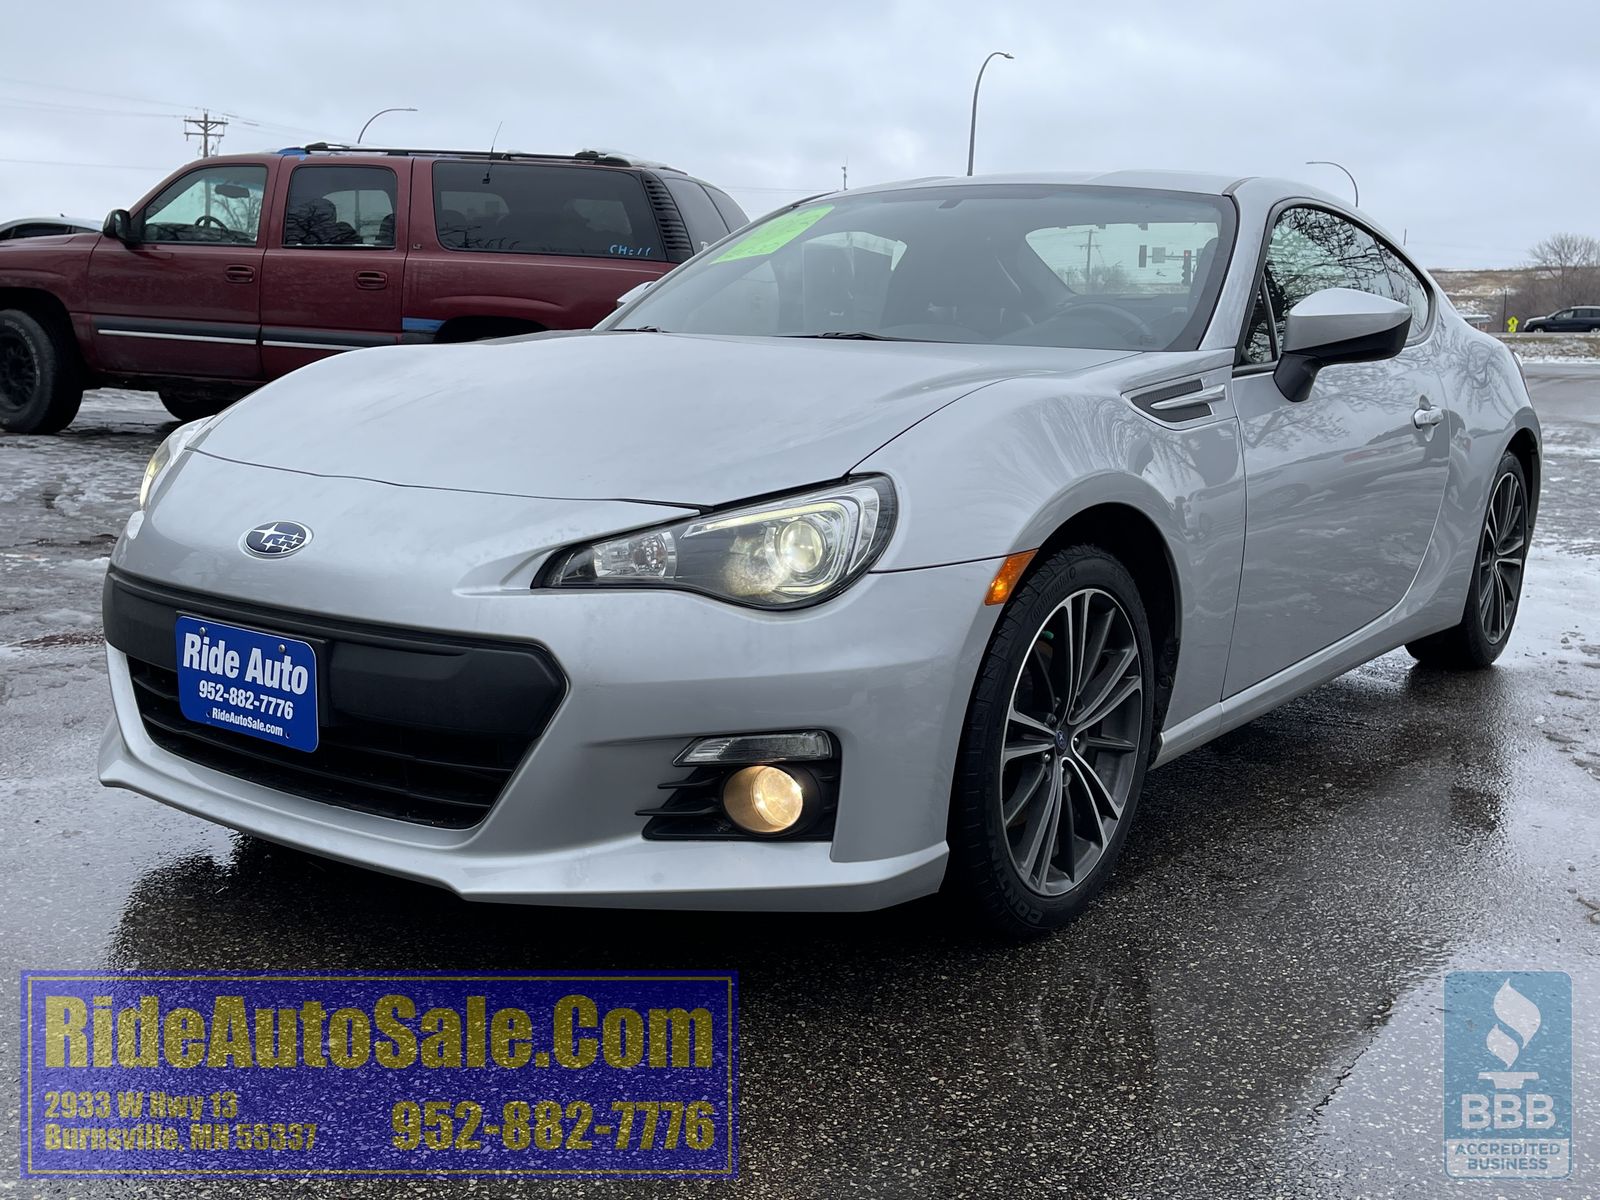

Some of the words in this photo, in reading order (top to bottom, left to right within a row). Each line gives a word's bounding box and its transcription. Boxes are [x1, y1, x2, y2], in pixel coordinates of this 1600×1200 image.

[183, 632, 240, 679] Ride
[244, 647, 309, 695] Auto
[199, 680, 294, 720] 952-882-7776
[212, 707, 284, 737] RideAutoSale.com
